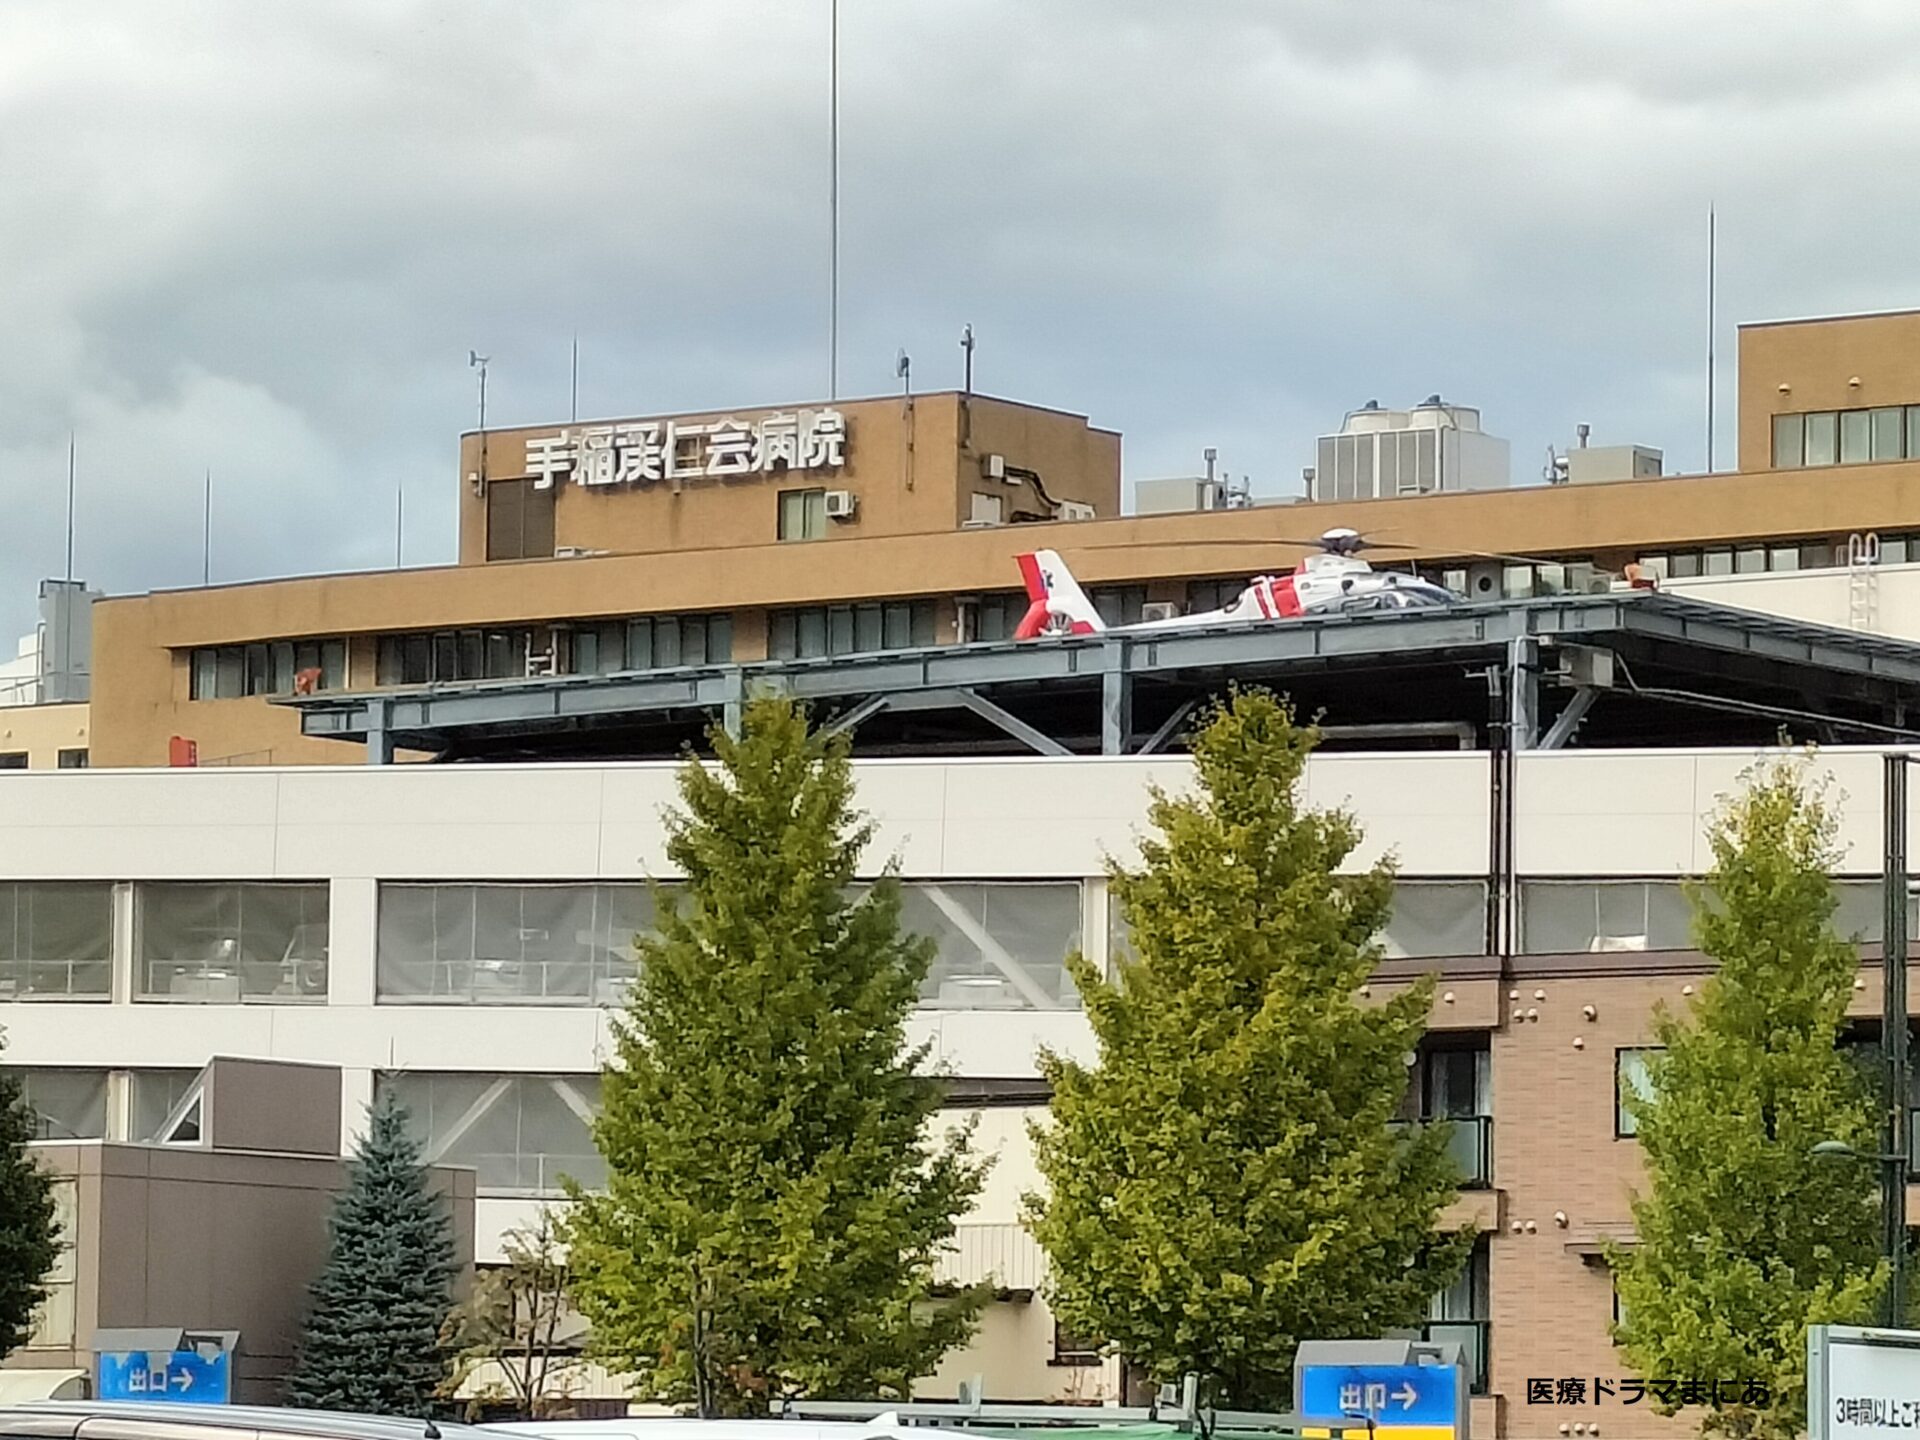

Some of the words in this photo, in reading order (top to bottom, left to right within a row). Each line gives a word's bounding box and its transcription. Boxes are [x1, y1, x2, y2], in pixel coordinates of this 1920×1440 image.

[525, 407, 846, 490] 手稲渓仁会病院
[129, 1366, 168, 1392] 出口
[1339, 1383, 1386, 1410] 出口
